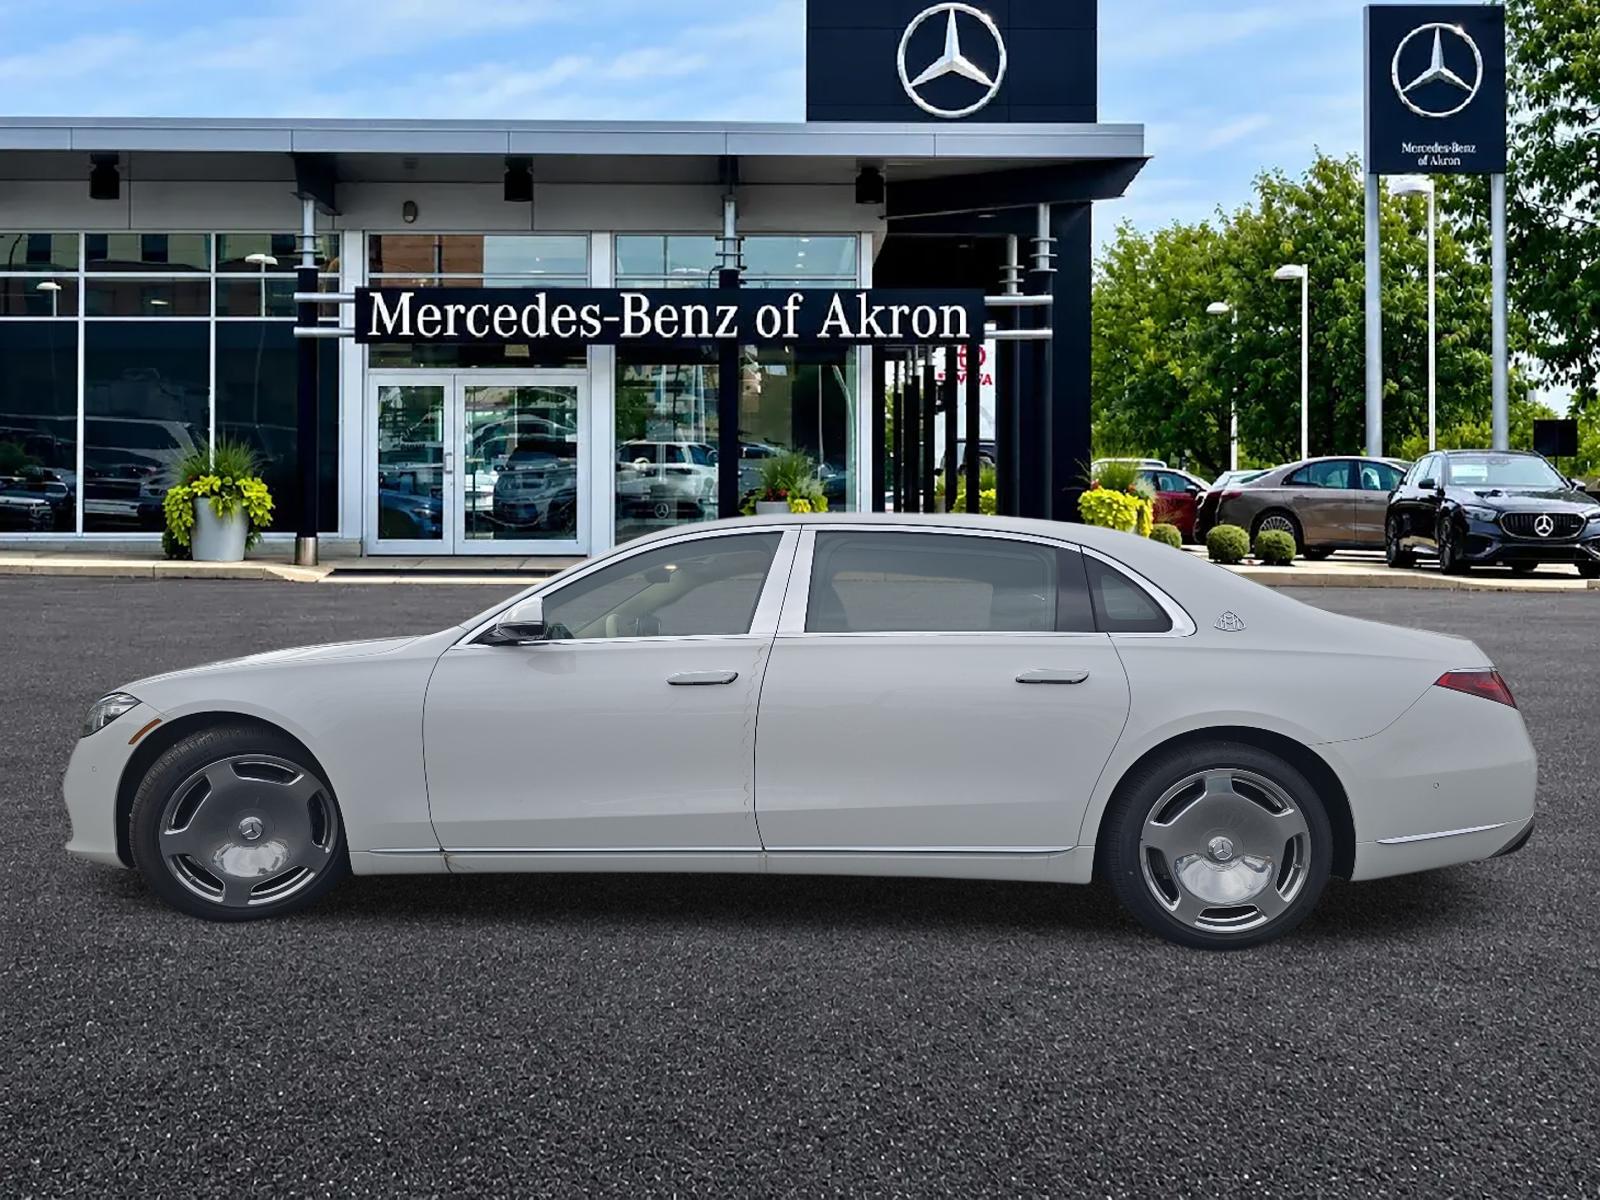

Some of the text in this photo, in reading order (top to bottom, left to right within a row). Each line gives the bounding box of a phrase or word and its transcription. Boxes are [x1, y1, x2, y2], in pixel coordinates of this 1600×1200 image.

[1401, 141, 1476, 154] Mercedes-Benz
[1417, 154, 1461, 166] of Akron
[367, 291, 971, 338] Mercedes-Benz of Akron
